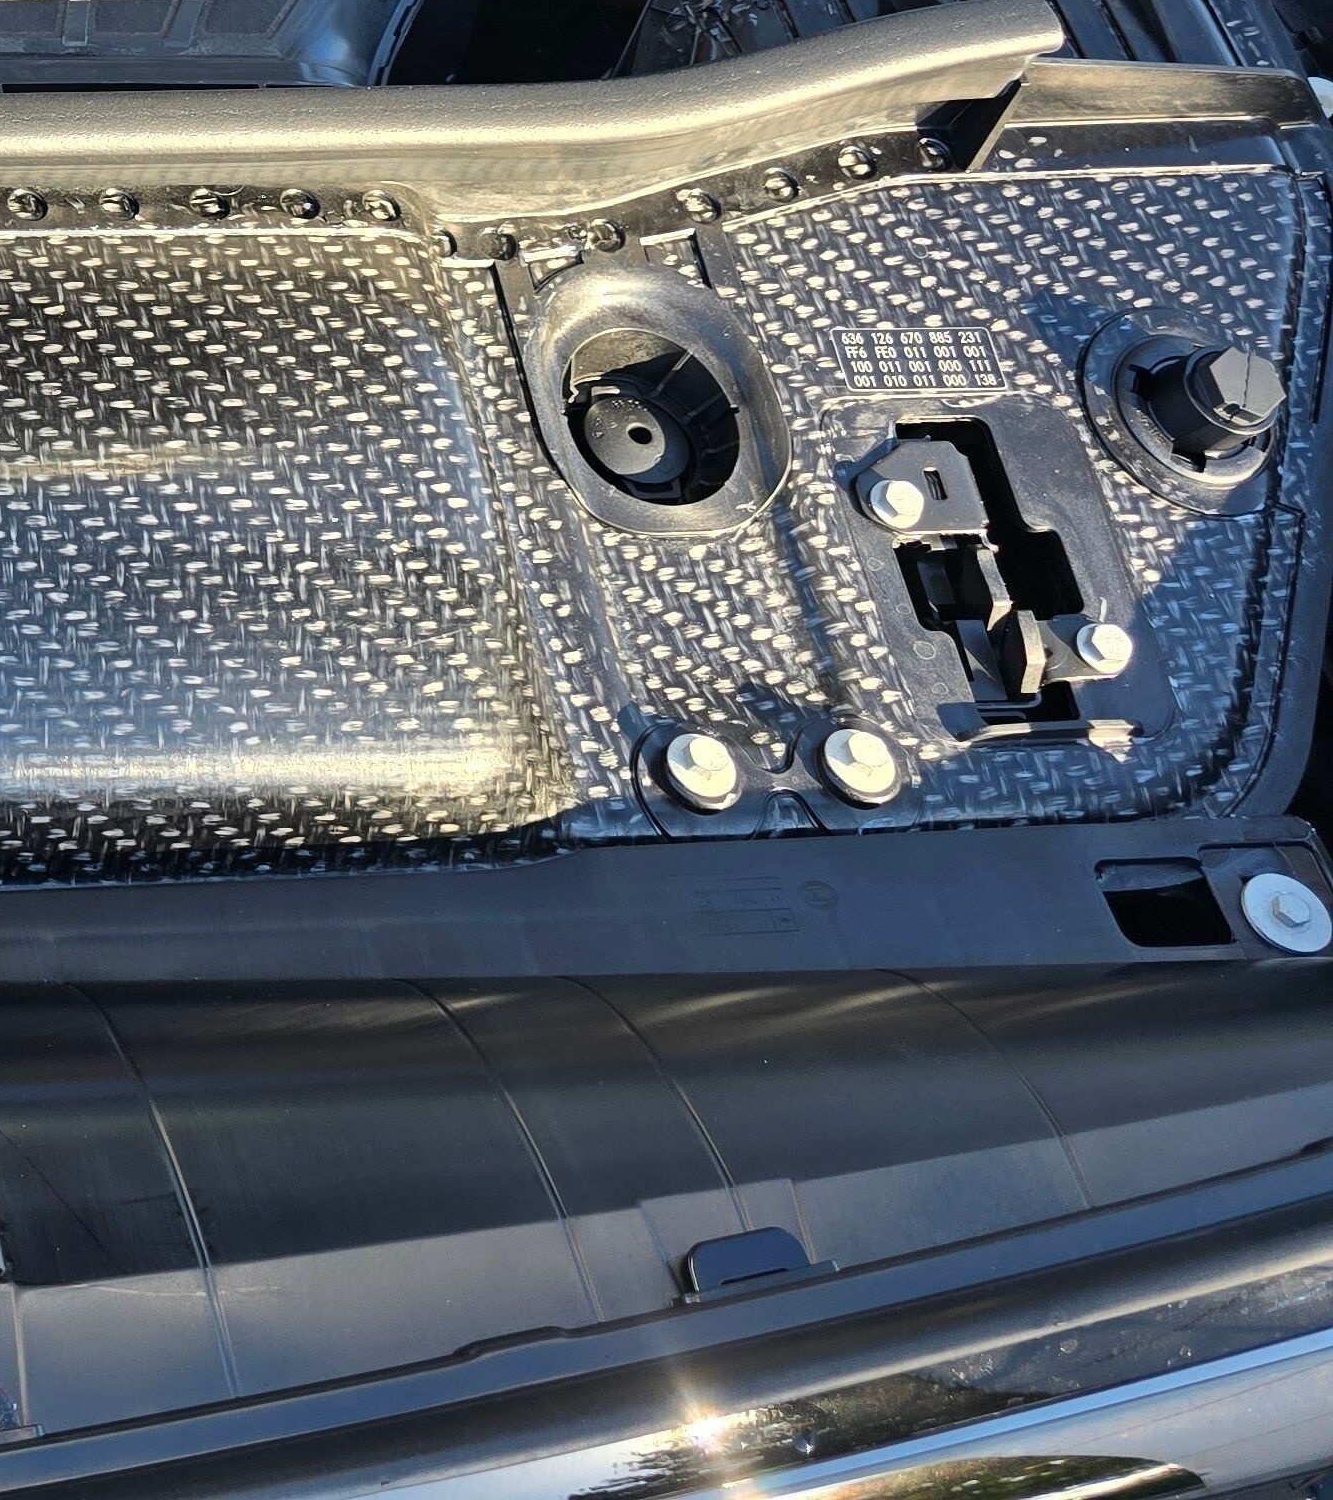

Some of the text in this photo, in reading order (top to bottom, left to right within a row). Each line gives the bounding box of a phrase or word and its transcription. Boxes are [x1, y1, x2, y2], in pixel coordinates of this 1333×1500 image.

[841, 332, 864, 345] 636
[871, 332, 894, 345] 126
[900, 332, 923, 344] 670
[958, 331, 981, 344] 231
[845, 346, 868, 359] FF6
[904, 346, 927, 358] 011
[934, 346, 957, 358] 001
[963, 346, 986, 358] 001
[851, 360, 992, 373] 100 011 001 000 111
[854, 374, 997, 388] 001 010 011 000 138
